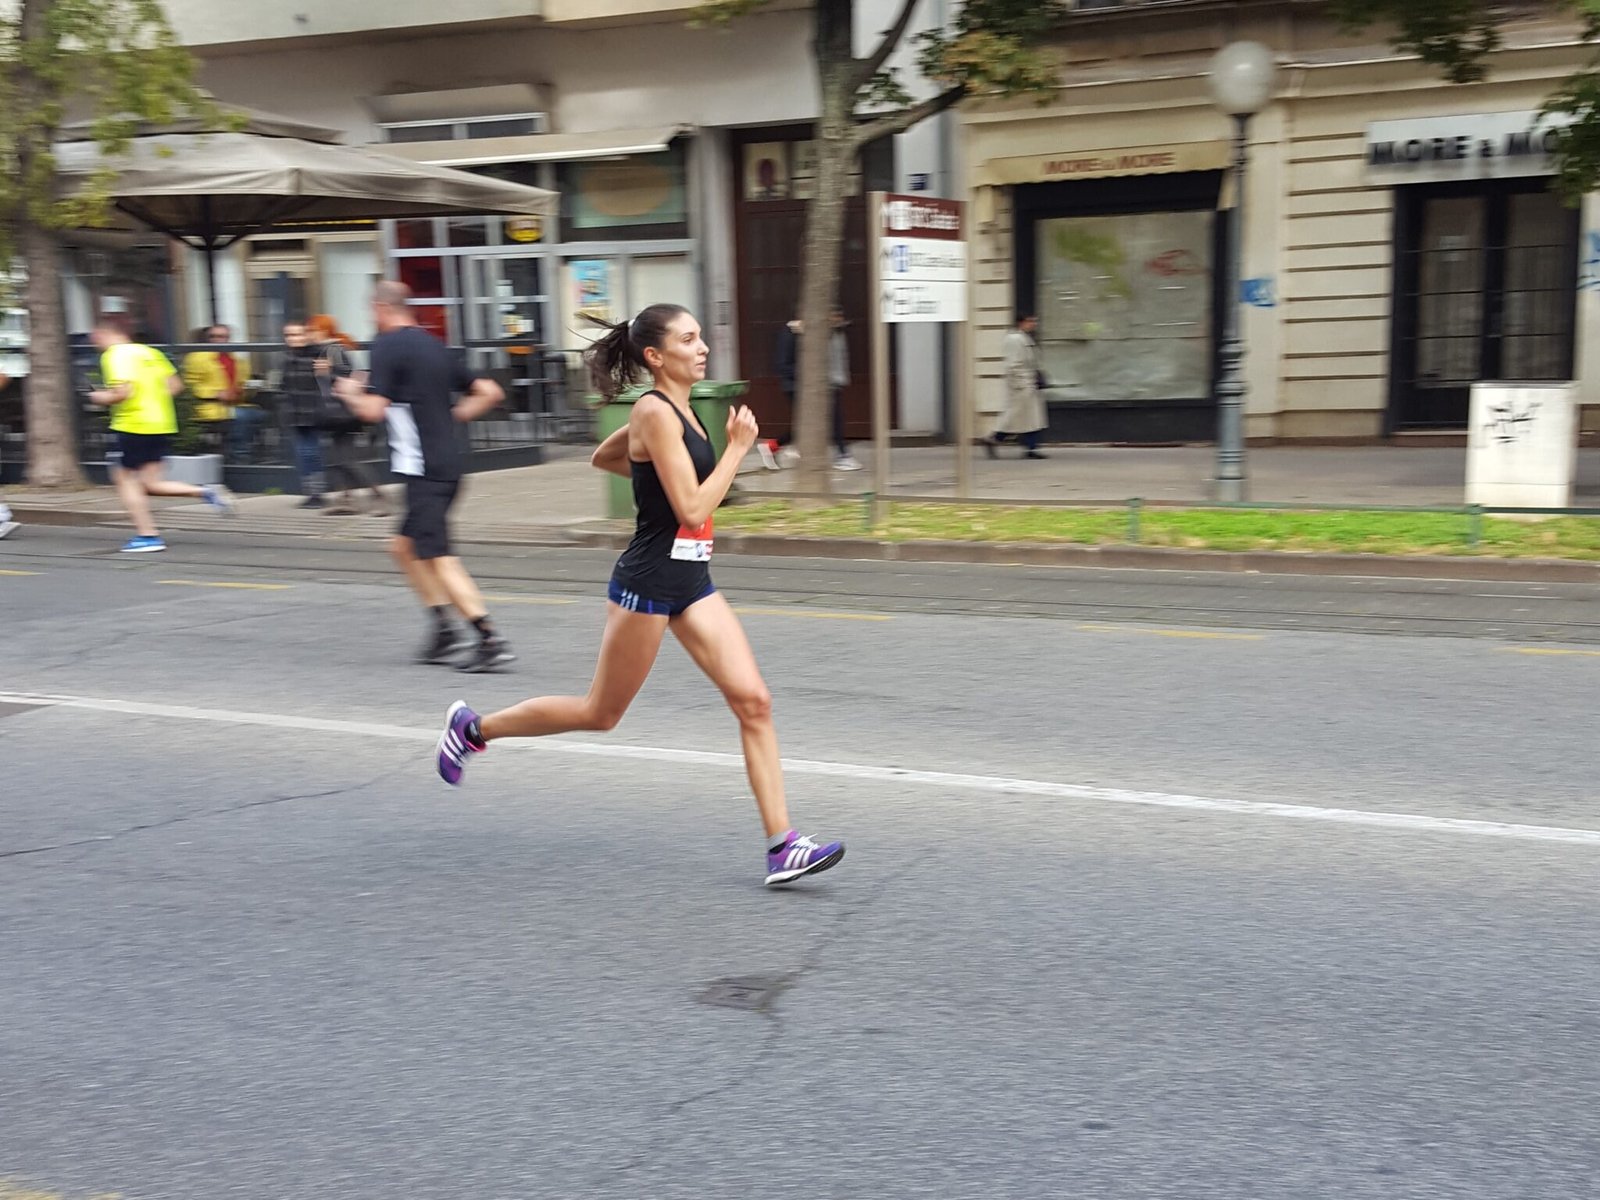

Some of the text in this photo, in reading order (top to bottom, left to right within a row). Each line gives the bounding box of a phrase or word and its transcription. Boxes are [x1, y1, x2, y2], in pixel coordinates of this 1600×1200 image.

[1044, 158, 1100, 174] MORE
[1119, 152, 1176, 169] MORE
[1368, 135, 1471, 165] MORE
[1480, 138, 1493, 158] &
